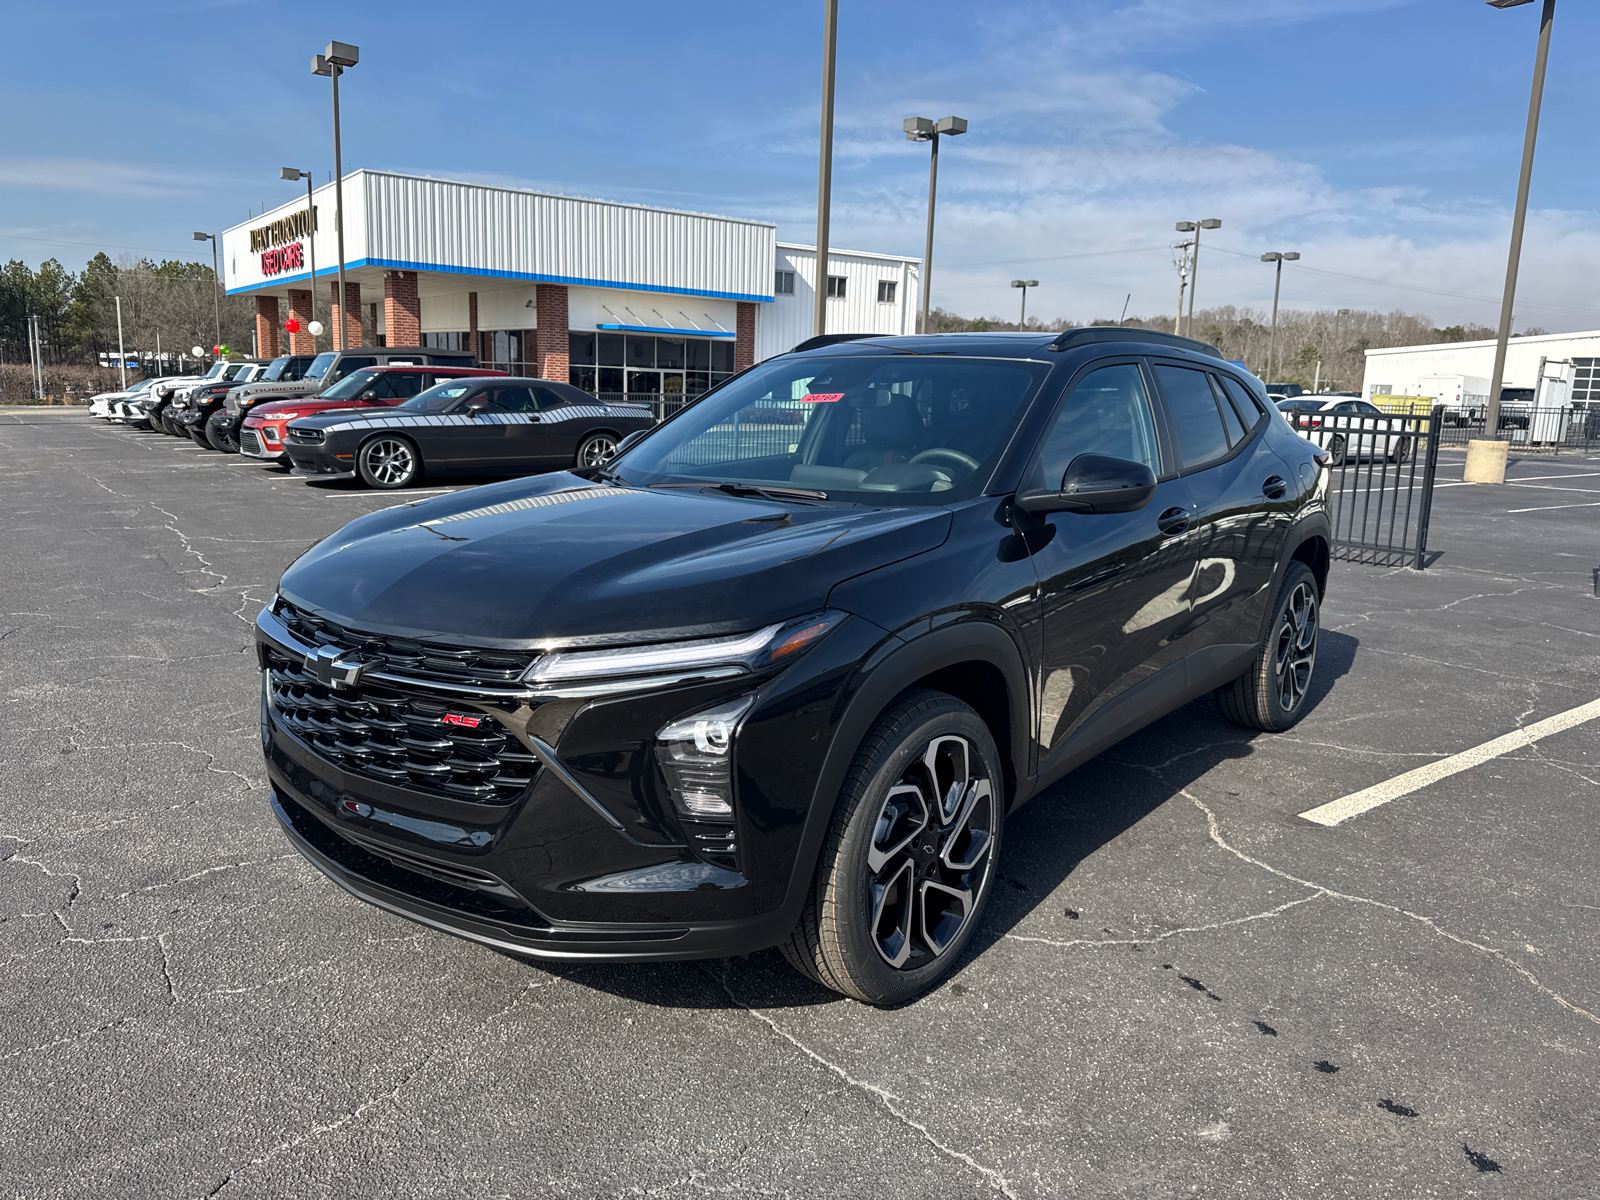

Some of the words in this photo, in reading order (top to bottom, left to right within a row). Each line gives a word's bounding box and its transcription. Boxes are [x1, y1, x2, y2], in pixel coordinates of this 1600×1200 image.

[249, 225, 269, 253] JOHN
[261, 248, 281, 275] USED
[280, 242, 304, 272] CARS
[442, 713, 481, 728] RS
